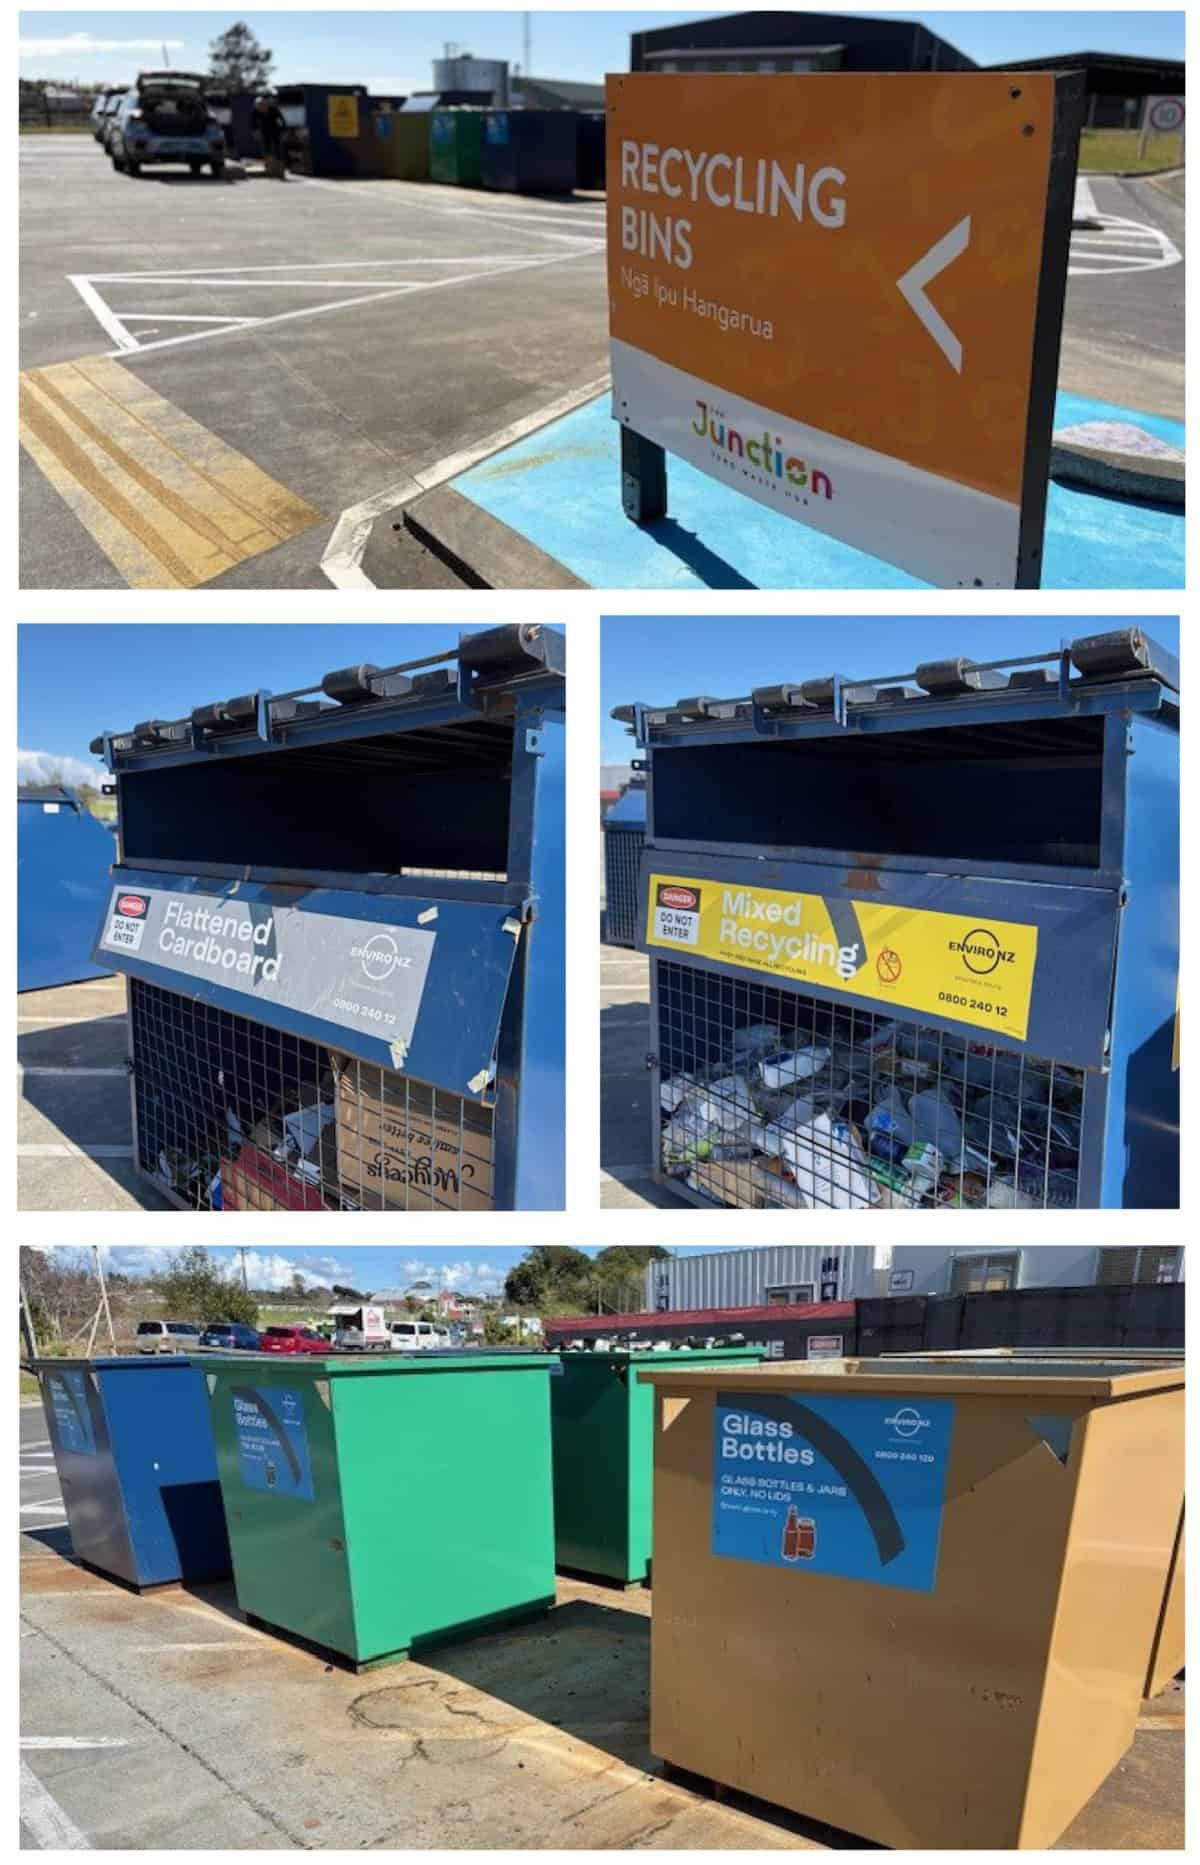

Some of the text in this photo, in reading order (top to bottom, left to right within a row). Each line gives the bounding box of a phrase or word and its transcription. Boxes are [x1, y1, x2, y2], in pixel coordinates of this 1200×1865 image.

[621, 139, 847, 229] RECYCLING
[621, 206, 694, 269] BINS
[654, 276, 678, 307] Ipu
[683, 287, 774, 340] Hangarua
[692, 399, 834, 500] Junction
[163, 901, 273, 945] Flattened
[660, 911, 692, 928] DO NOT
[722, 890, 802, 927] Mixed
[663, 924, 689, 939] ENTER
[719, 919, 859, 978] Recycling
[159, 928, 283, 981] Cardboard
[938, 991, 1008, 1017] 0800 240 12
[722, 1414, 793, 1439] Glass
[721, 1437, 815, 1466] Bottles
[721, 1475, 757, 1487] GLASS
[758, 1478, 804, 1492] BOTTLES
[817, 1485, 847, 1496] JARS
[750, 1488, 767, 1500] NO
[768, 1490, 792, 1502] LIDS
